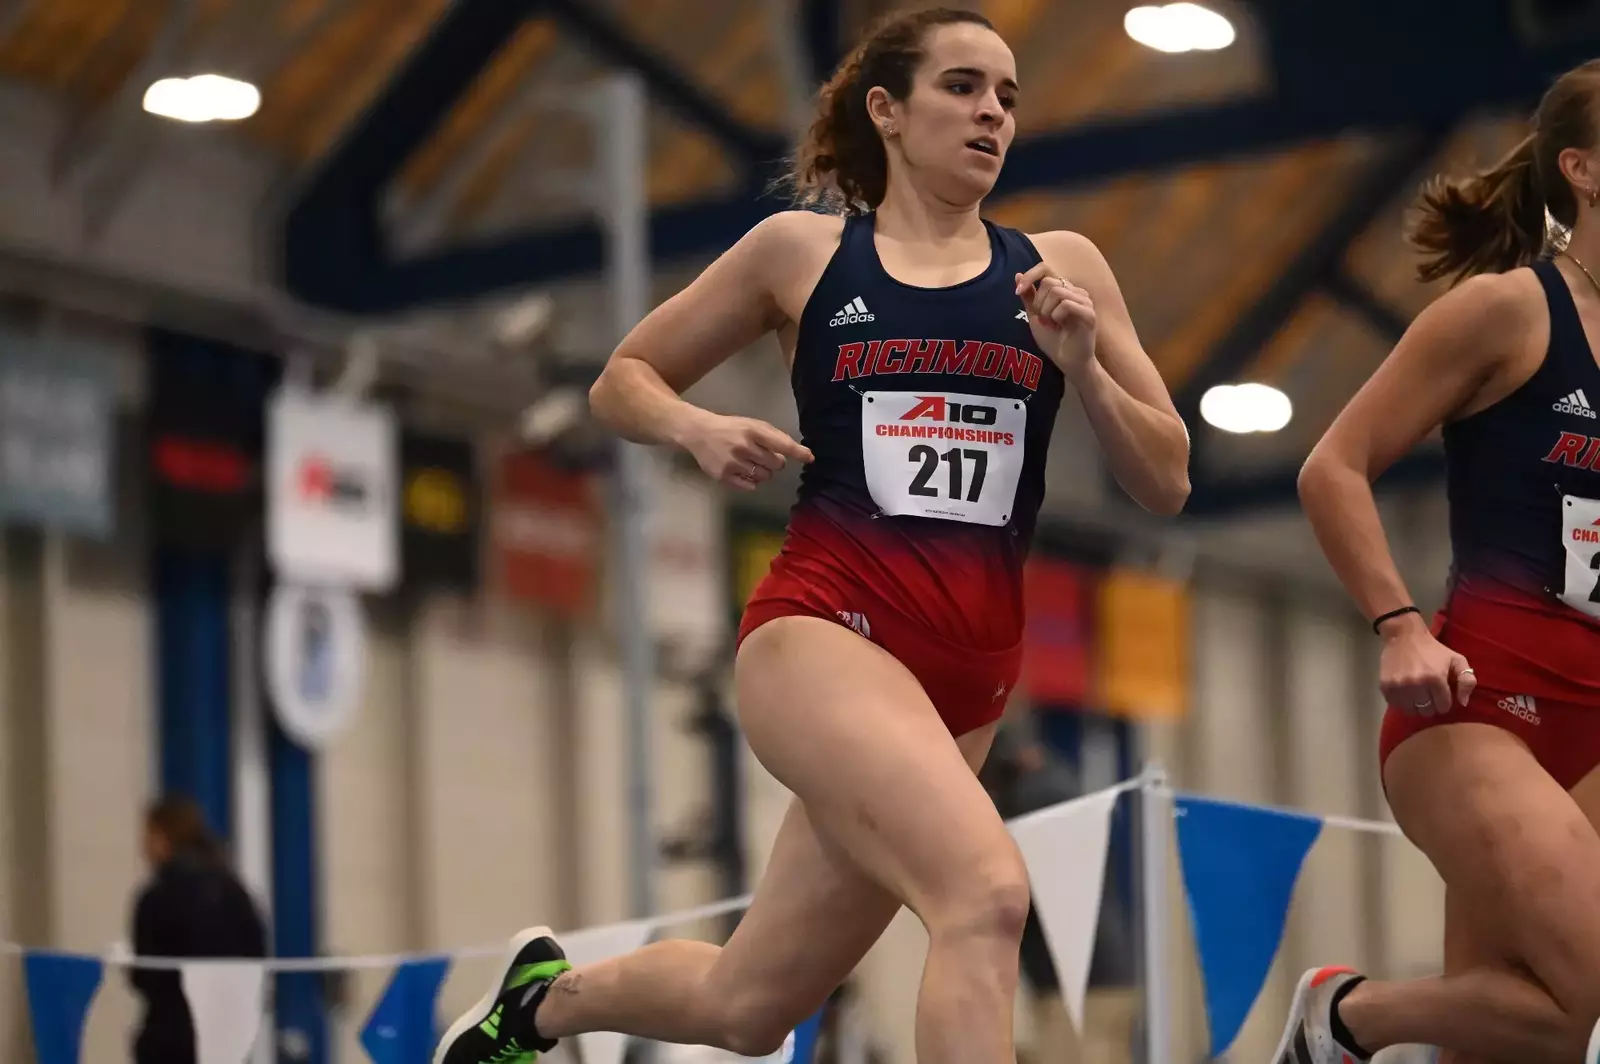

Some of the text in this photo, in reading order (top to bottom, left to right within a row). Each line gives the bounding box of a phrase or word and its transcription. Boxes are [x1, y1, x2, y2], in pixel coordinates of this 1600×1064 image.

[829, 312, 875, 327] adidas
[831, 339, 1043, 391] RICHMOND
[1552, 402, 1597, 419] adidas
[875, 424, 1014, 446] CHAMPIONSHIPS
[908, 444, 988, 503] 217
[1497, 700, 1541, 725] adidas
